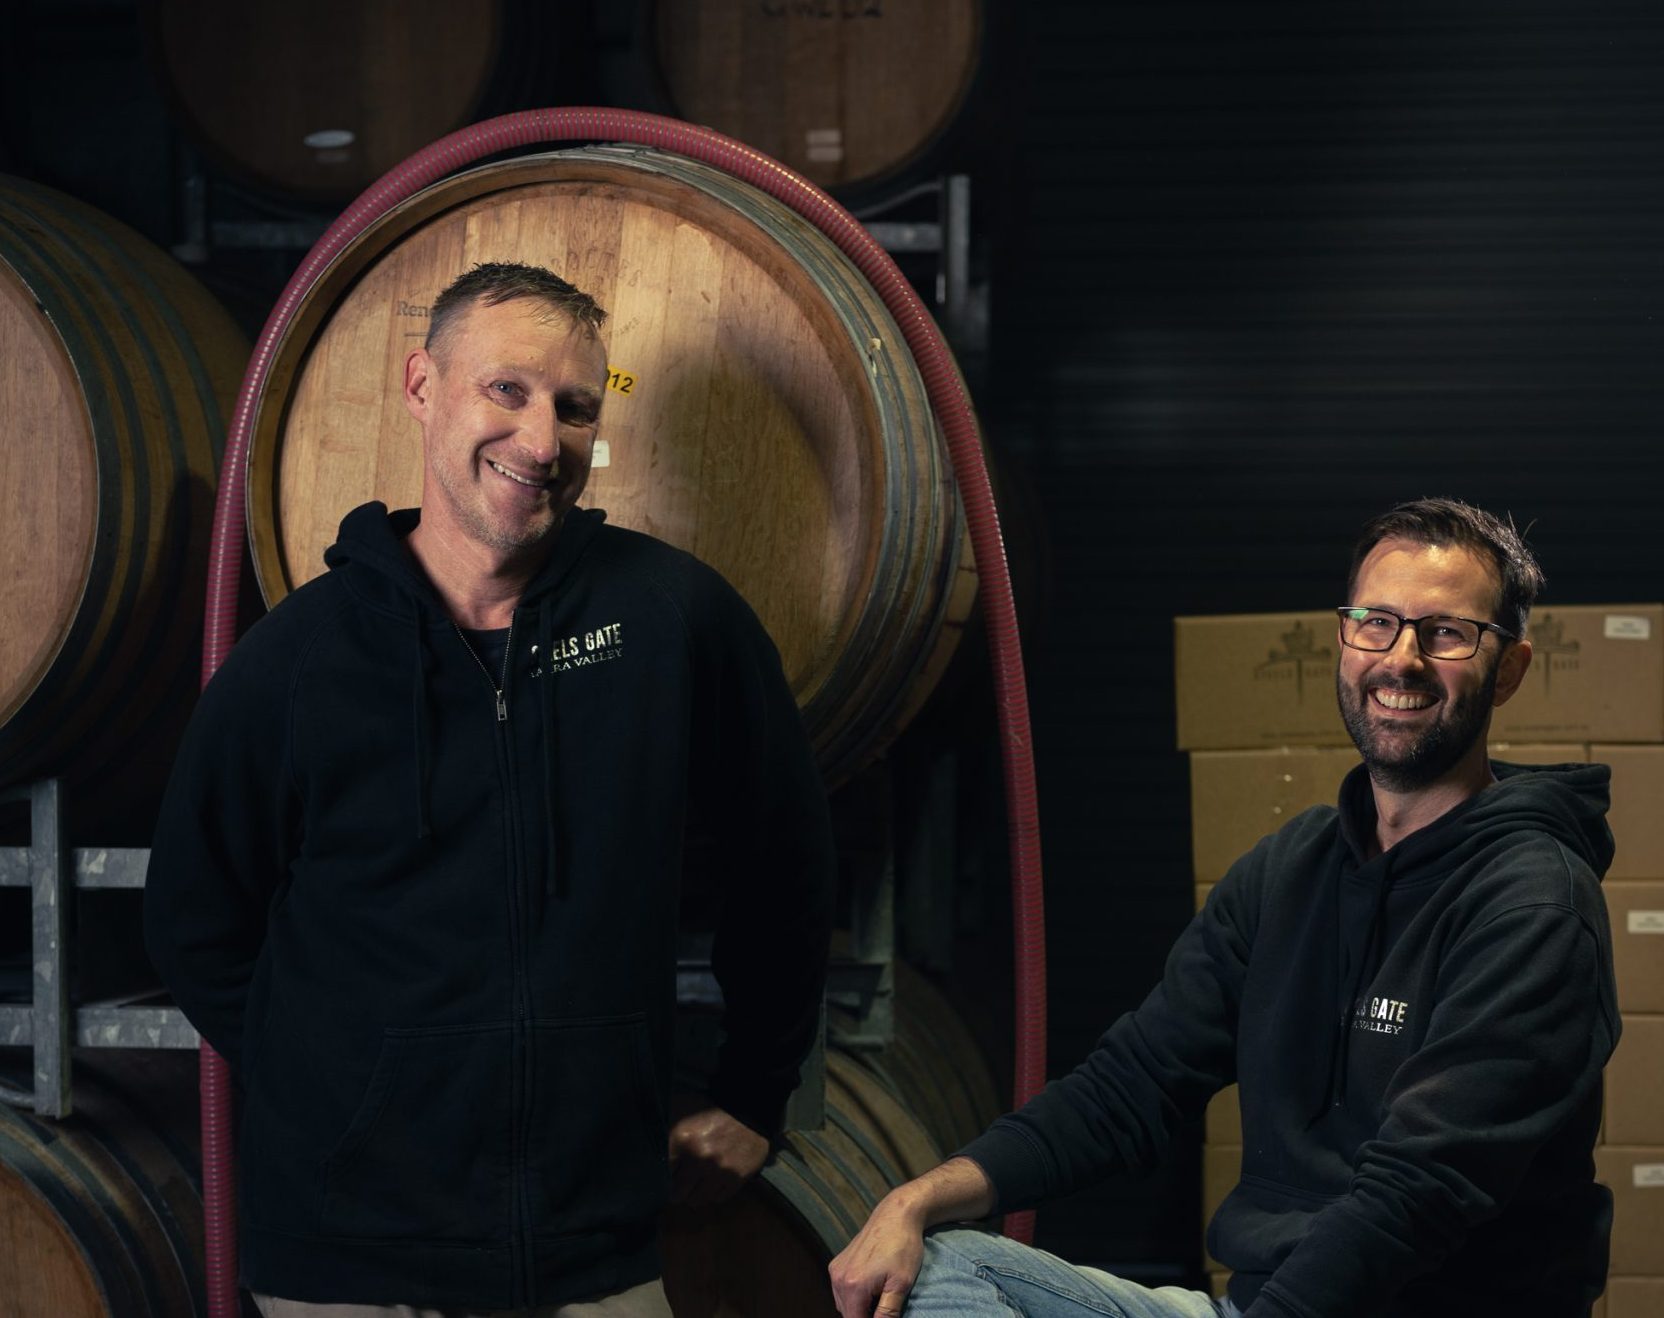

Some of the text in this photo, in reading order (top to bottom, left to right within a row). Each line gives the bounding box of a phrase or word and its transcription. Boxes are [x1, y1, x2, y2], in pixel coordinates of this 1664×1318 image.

[606, 368, 633, 393] 12
[585, 622, 623, 652] GATE
[573, 648, 624, 668] VALLEY
[1370, 996, 1409, 1023] GATE
[1359, 1020, 1403, 1035] VALLEY
